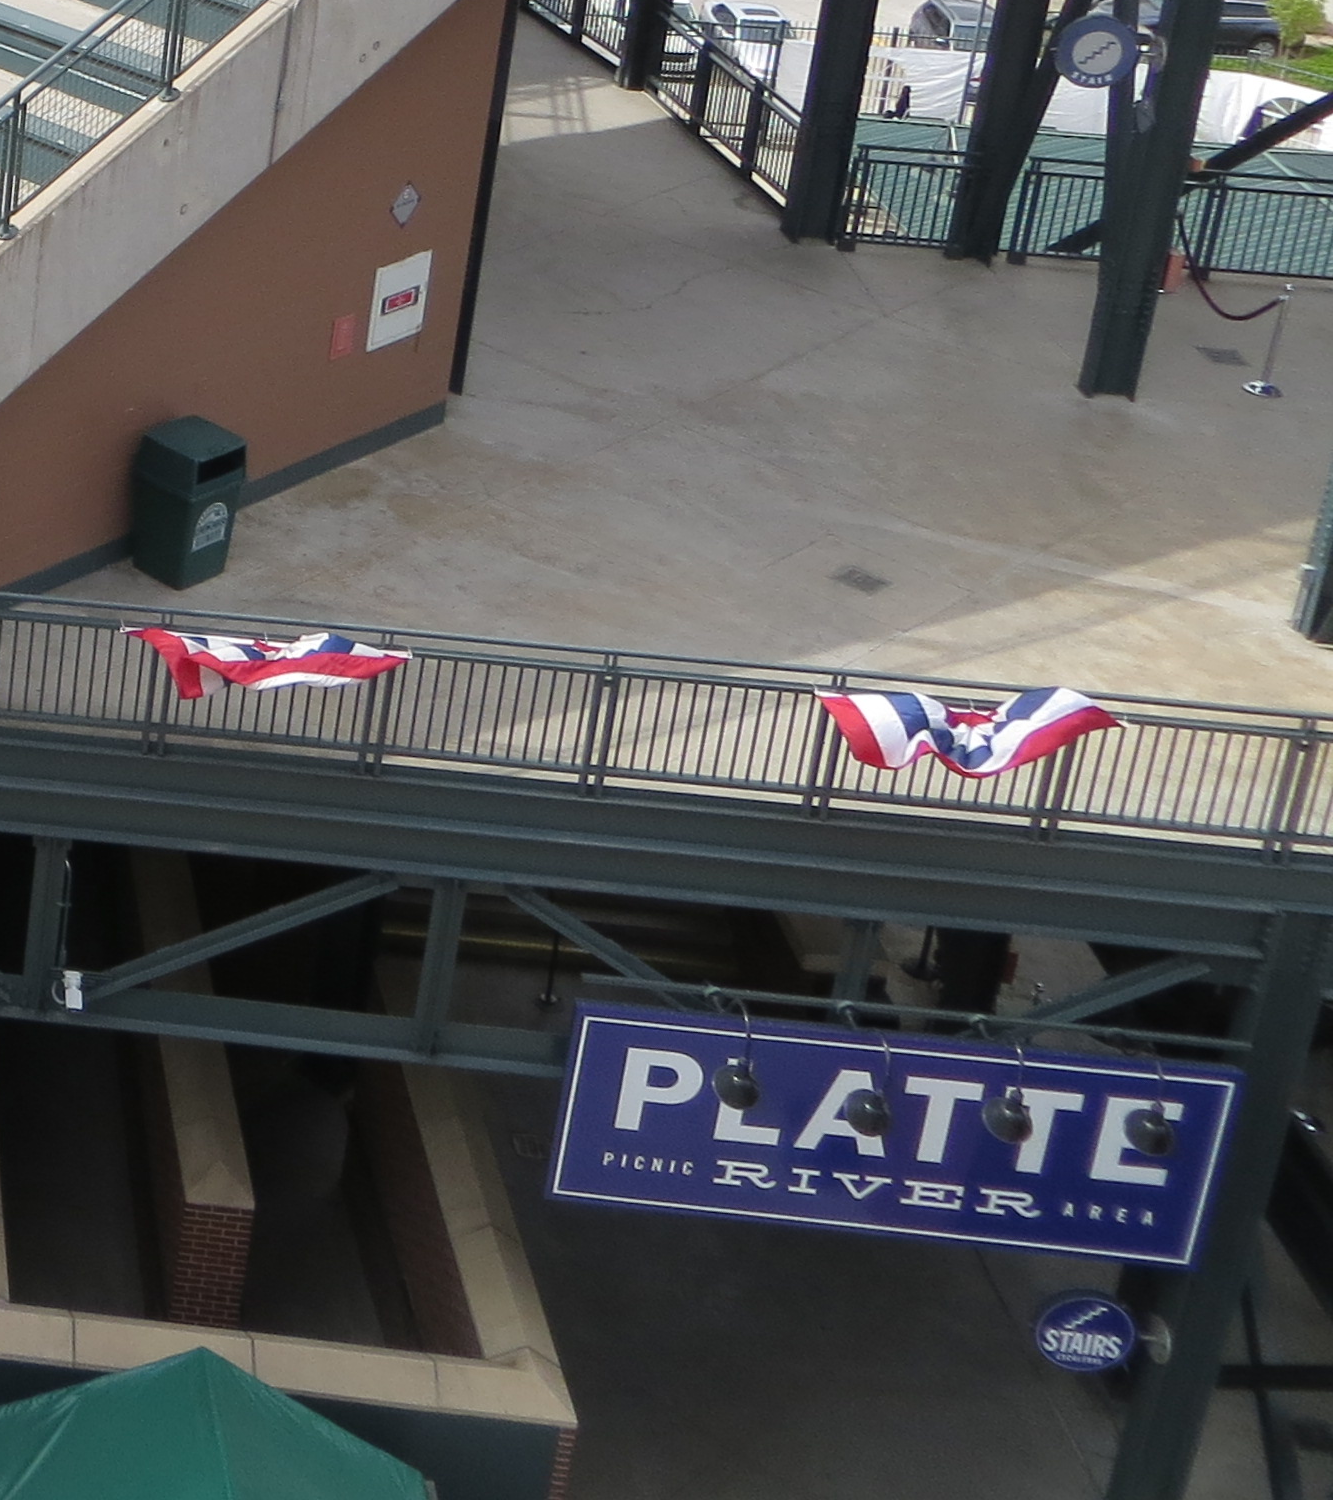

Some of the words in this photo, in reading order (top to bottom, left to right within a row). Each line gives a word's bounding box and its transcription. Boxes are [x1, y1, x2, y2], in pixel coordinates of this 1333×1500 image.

[612, 1046, 1184, 1188] PLATTE
[602, 1151, 696, 1177] PICNIC
[712, 1158, 1042, 1220] RIVER
[1062, 1201, 1156, 1227] AREA
[1042, 1328, 1123, 1359] STAIRS
